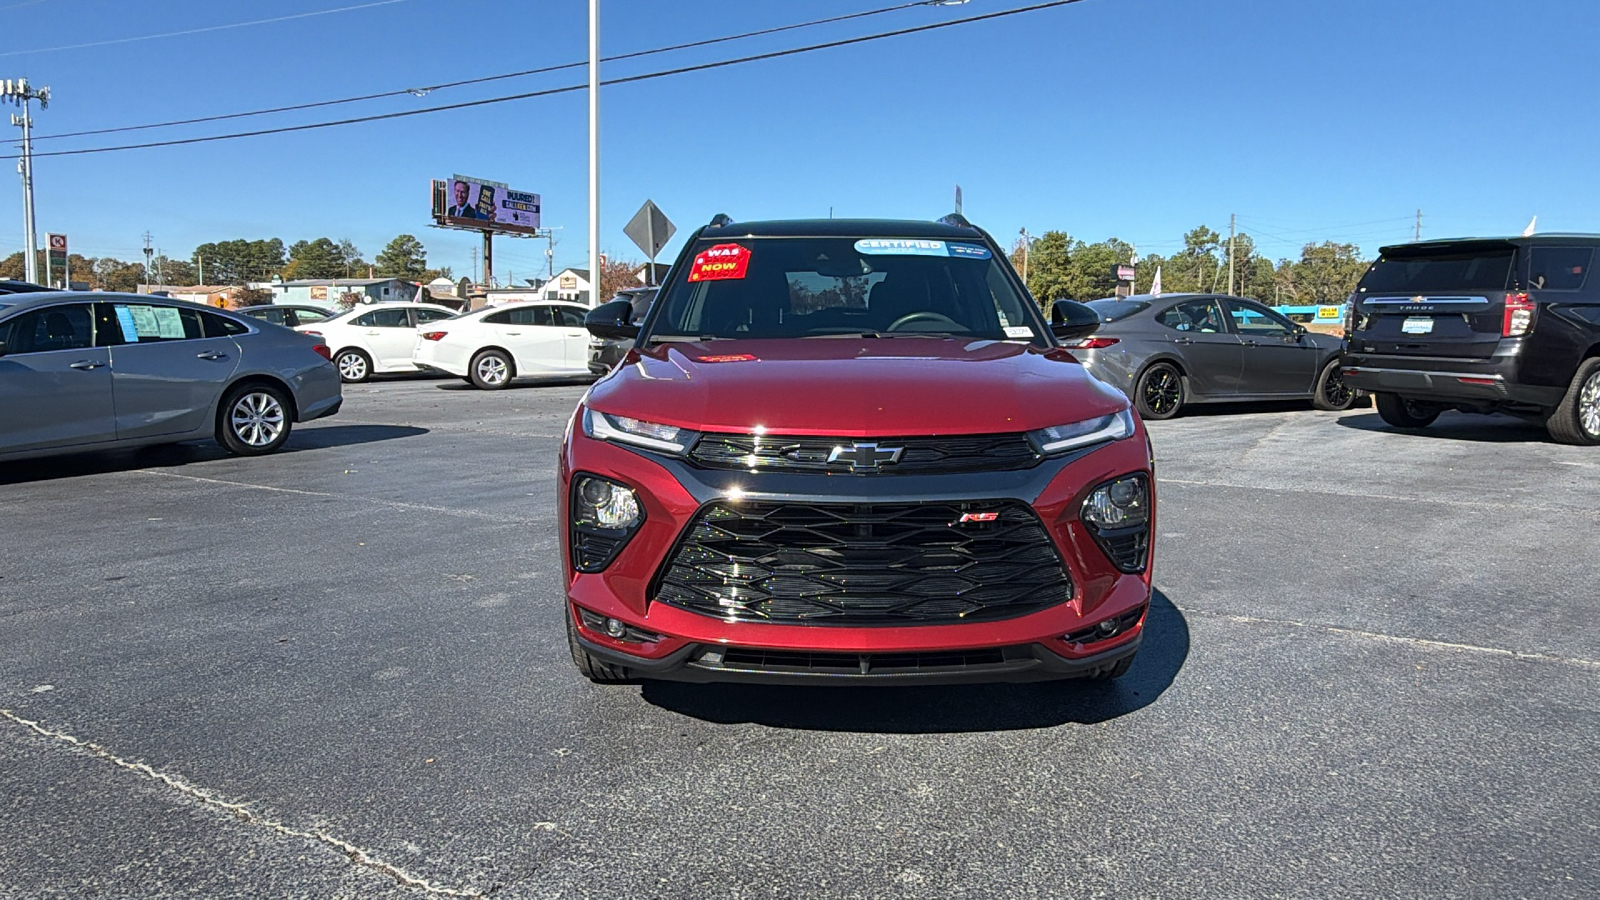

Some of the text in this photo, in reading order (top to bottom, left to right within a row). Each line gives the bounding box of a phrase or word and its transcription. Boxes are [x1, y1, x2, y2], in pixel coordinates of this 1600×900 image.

[859, 240, 942, 249] CERTIFIED
[708, 248, 740, 257] WAS
[701, 262, 737, 272] NOW
